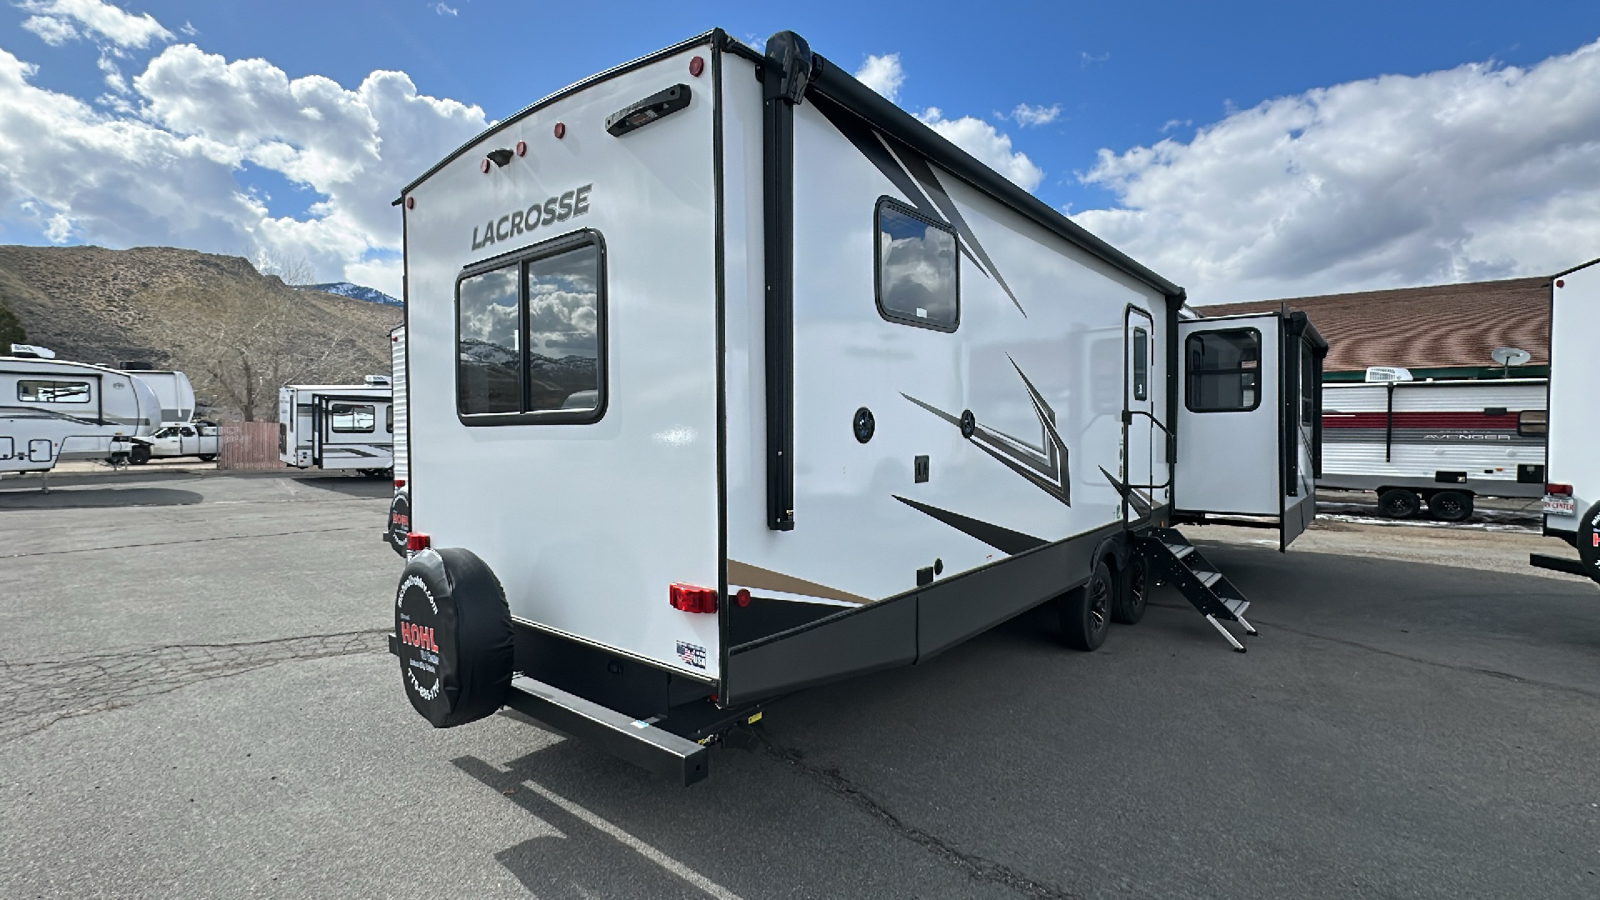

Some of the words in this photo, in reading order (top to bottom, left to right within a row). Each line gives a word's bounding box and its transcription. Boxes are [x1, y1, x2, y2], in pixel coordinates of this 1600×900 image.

[471, 182, 593, 251] LACROSSE
[1552, 502, 1573, 510] CENTER
[400, 621, 439, 654] HOHL
